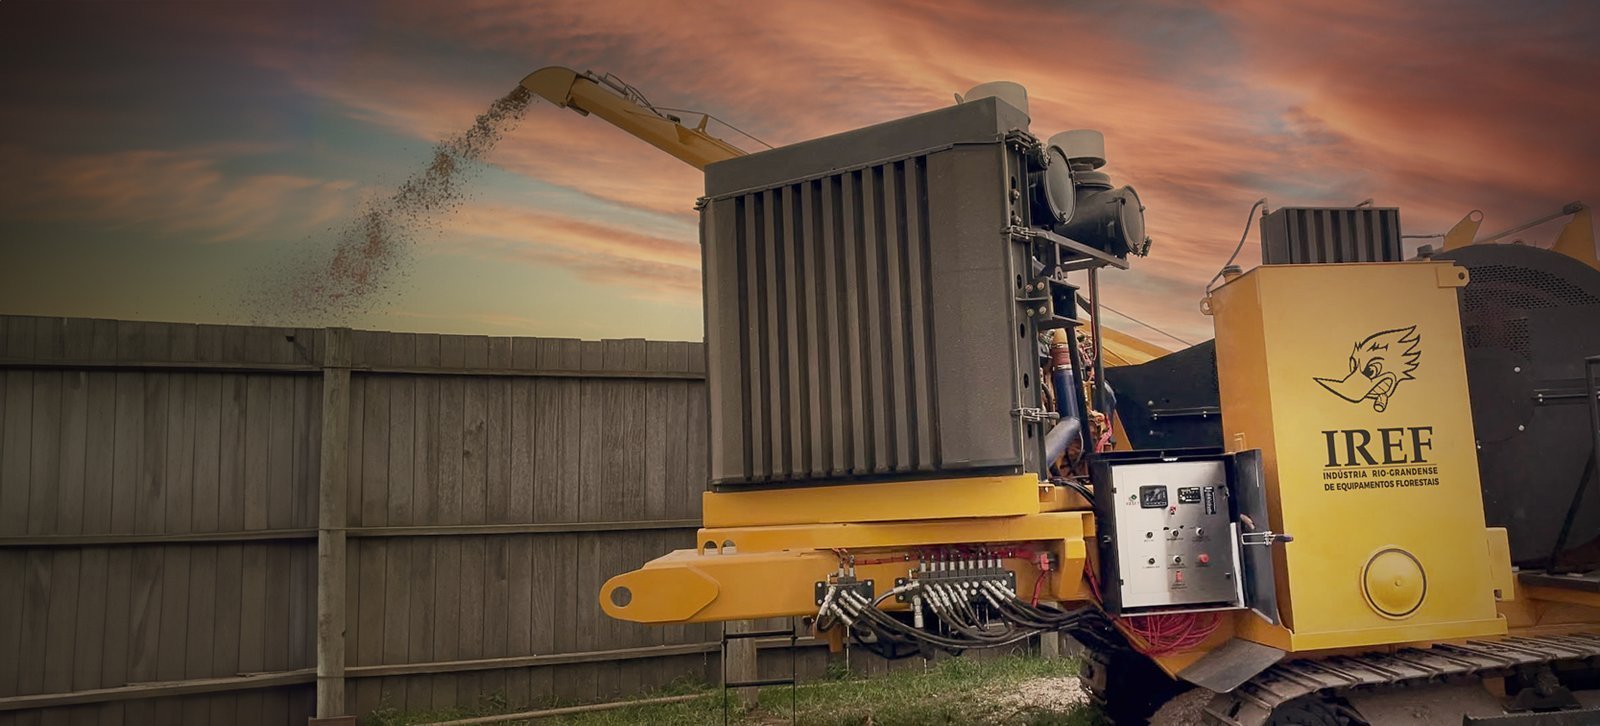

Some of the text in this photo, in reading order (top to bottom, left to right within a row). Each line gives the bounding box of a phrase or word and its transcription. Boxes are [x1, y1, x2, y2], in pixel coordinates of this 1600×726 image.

[1321, 426, 1433, 467] IREF
[1323, 467, 1438, 480] INDÚSTRIA RIO-GRANDENSE
[1324, 478, 1440, 491] DE EQUIPAMENTOS FLORESTAIS
